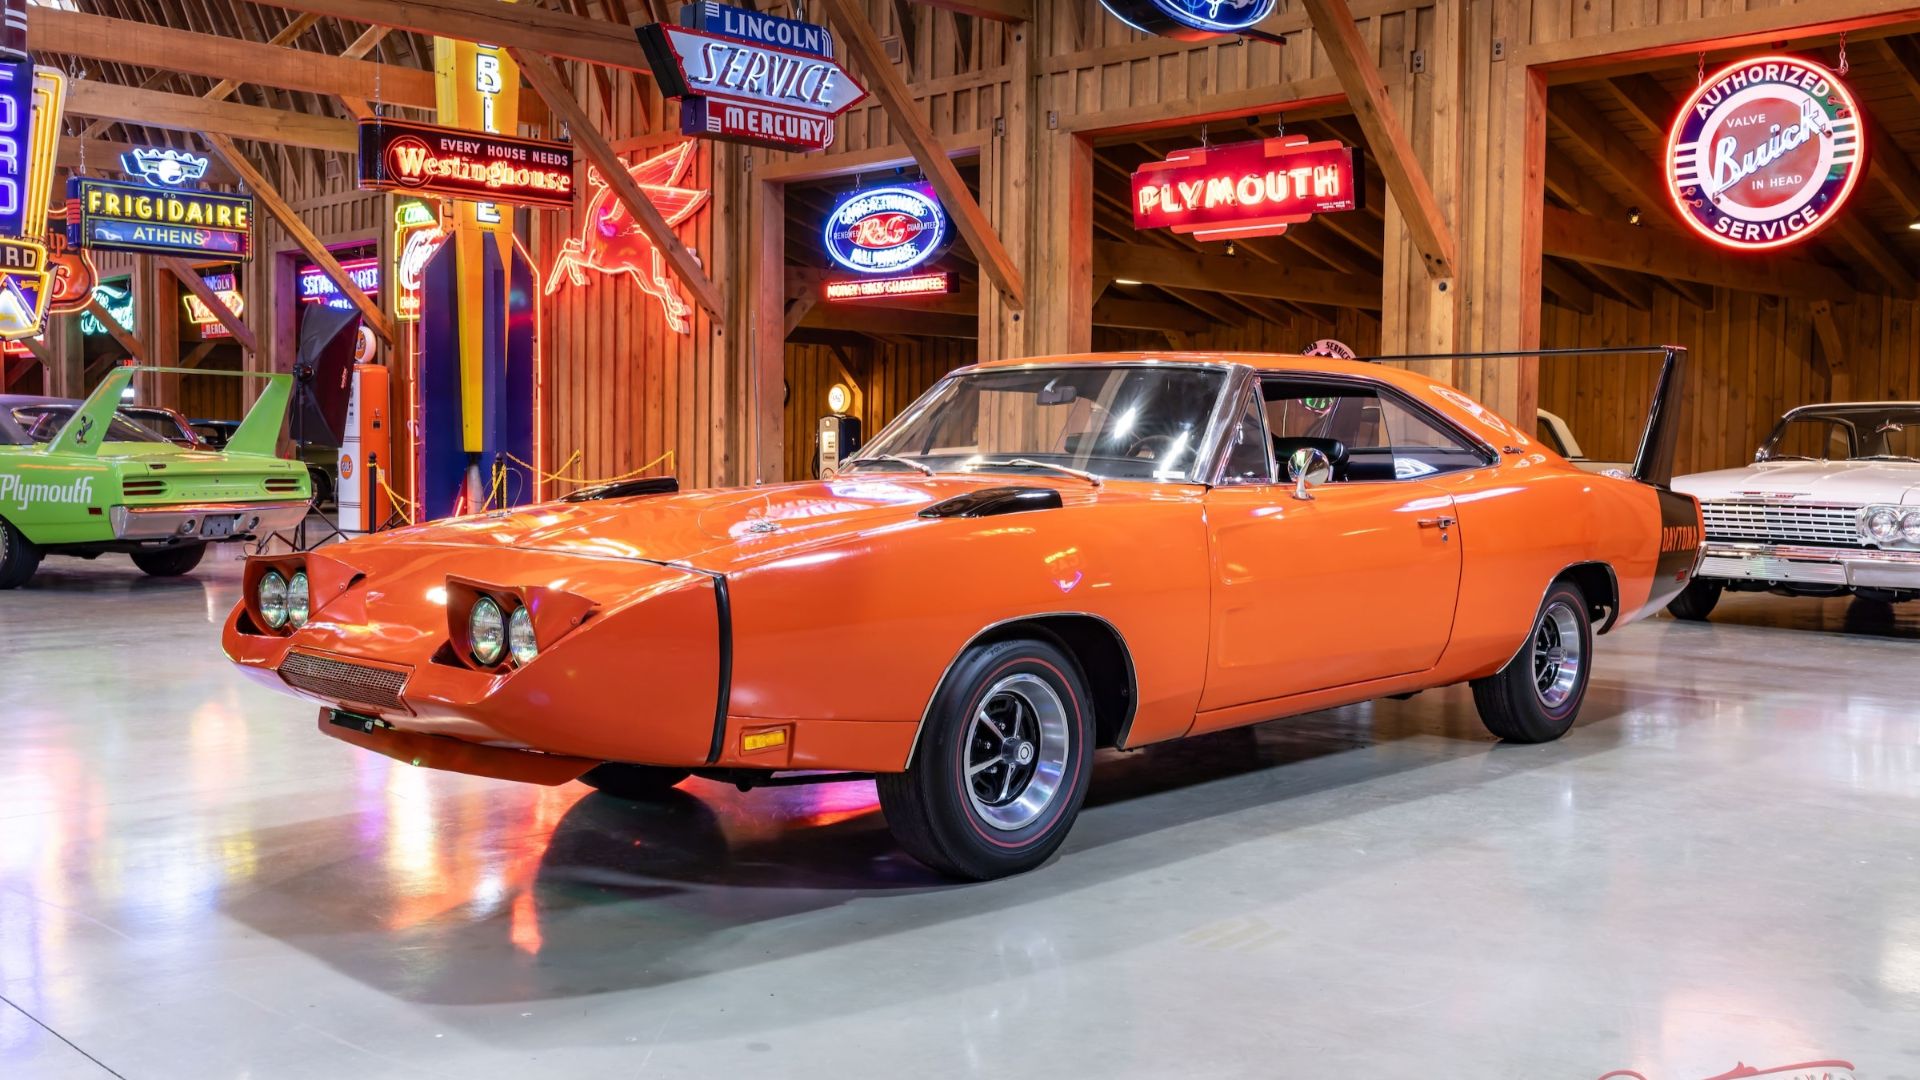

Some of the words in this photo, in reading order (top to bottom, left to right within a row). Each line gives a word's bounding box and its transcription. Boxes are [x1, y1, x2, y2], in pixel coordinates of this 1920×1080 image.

[724, 10, 819, 51] LINCOLN
[698, 42, 840, 107] SERVICE
[1695, 64, 1830, 120] AUTHORIZED
[725, 107, 824, 142] MERCURY
[1726, 113, 1766, 129] VALVE
[440, 138, 480, 154] EVERY
[487, 145, 526, 160] HOUSE
[532, 151, 568, 166] NEEDS
[1711, 97, 1827, 199] Buick
[394, 146, 571, 192] Westinghouse
[1752, 179, 1764, 190] IN
[1770, 175, 1802, 188] HEAD
[1138, 164, 1340, 215] PLYMOUTH
[88, 190, 248, 228] FRIGIDAIRE
[1714, 205, 1819, 241] SERVICE
[133, 227, 205, 246] ATHENS
[0, 474, 94, 511] Plymouth
[1662, 526, 1697, 552] DAYTONA
